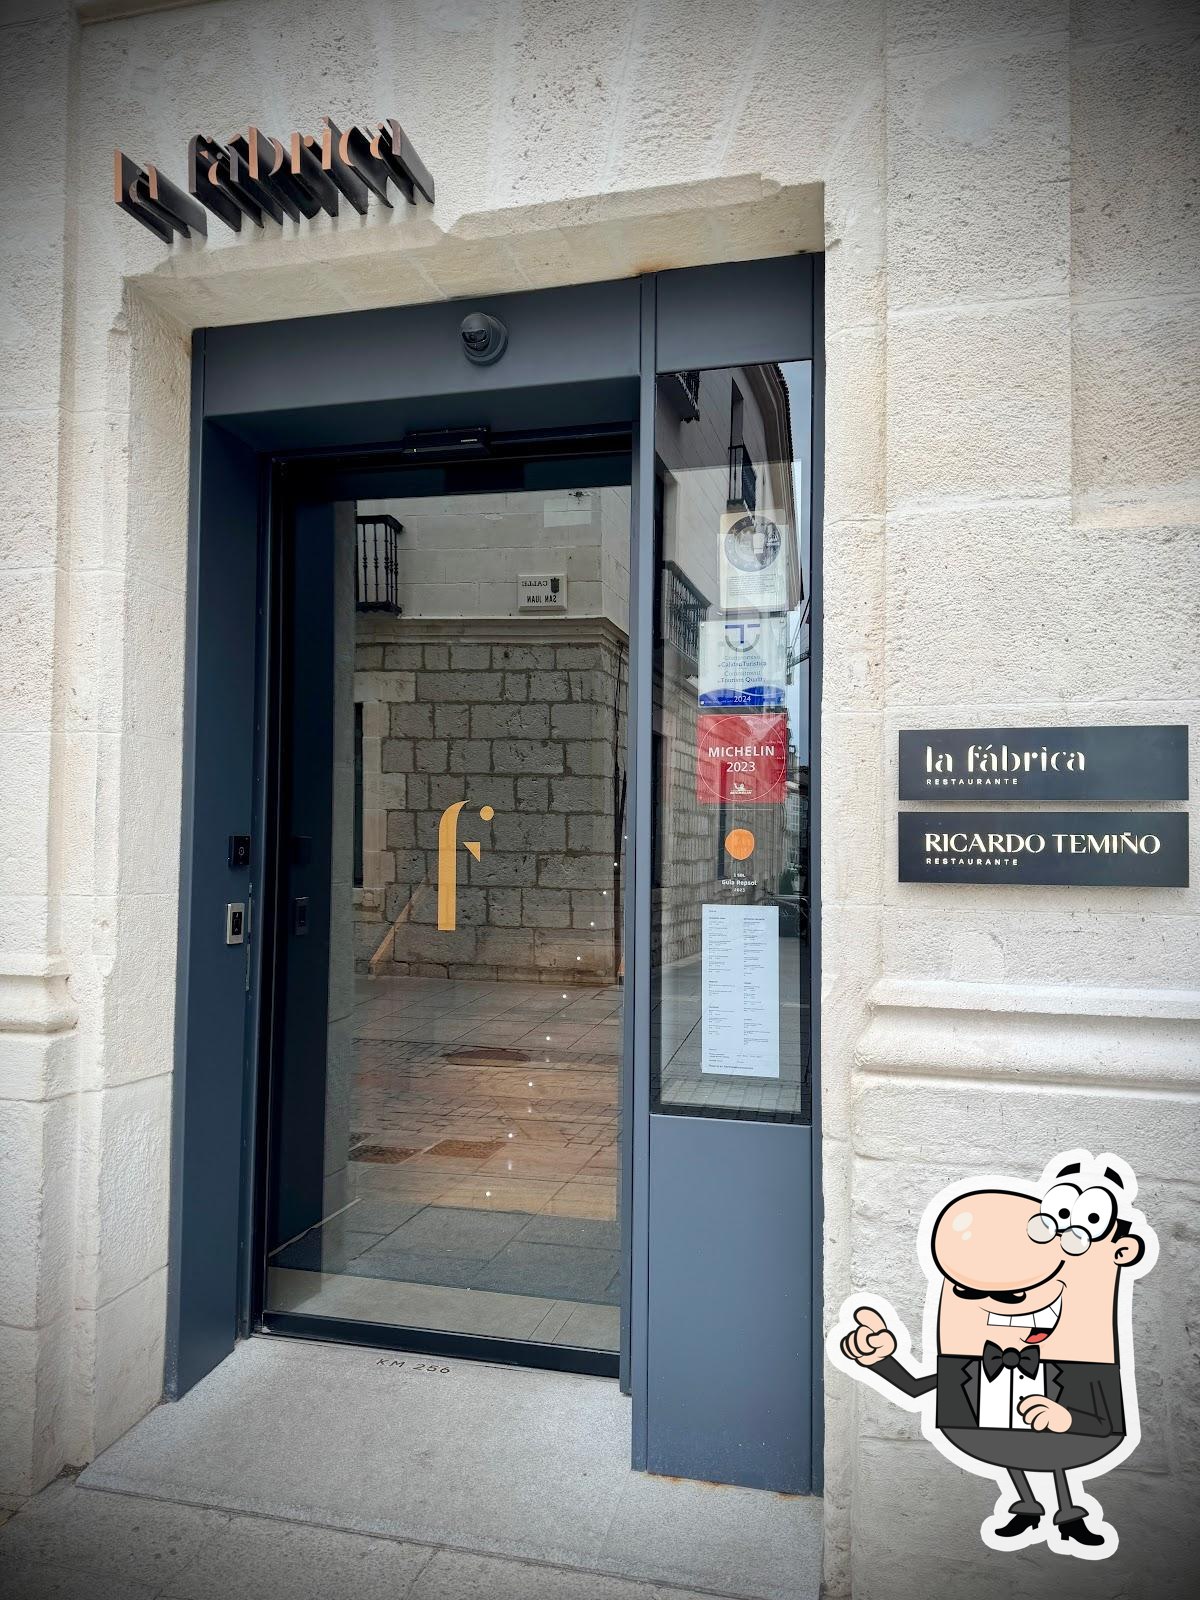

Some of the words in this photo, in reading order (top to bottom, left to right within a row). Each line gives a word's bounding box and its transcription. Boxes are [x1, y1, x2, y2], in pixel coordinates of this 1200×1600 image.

[708, 745, 775, 758] MICHELIN
[926, 745, 953, 773] la
[967, 744, 1085, 772] fábrica
[726, 761, 756, 773] 2023
[925, 833, 1046, 854] RICARDO
[1051, 832, 1161, 855] TEMIÑO
[926, 857, 1018, 866] RESTAURANTE
[376, 1358, 406, 1368] KM
[412, 1363, 451, 1374] 256
